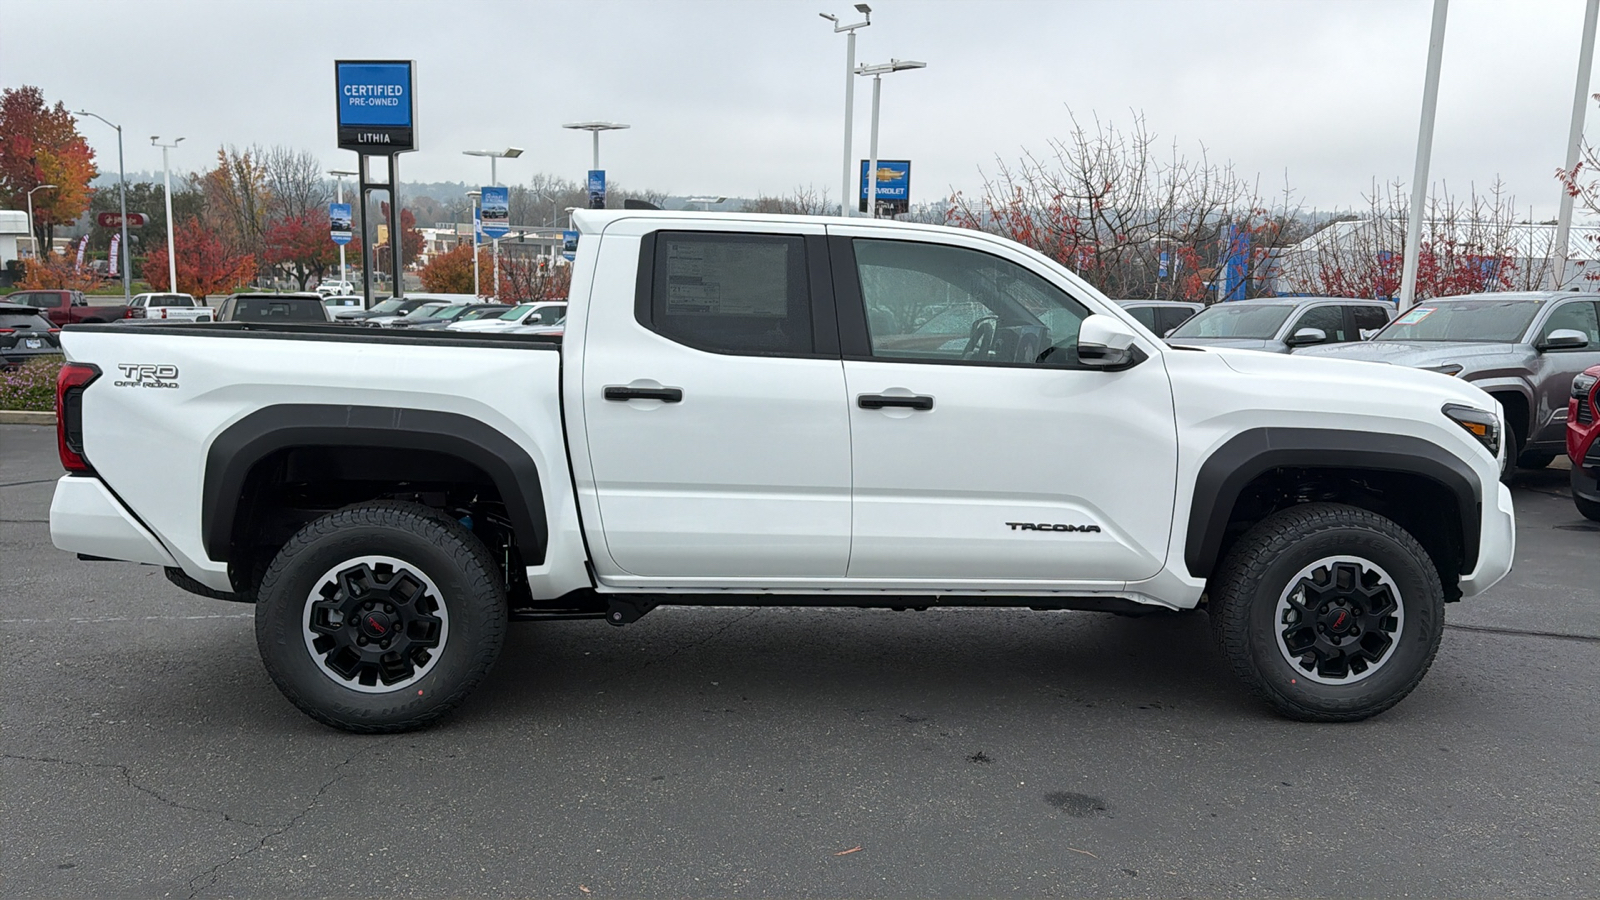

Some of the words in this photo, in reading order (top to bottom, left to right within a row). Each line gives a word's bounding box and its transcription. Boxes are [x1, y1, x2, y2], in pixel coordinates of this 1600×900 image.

[344, 85, 403, 96] CERTIFIED
[349, 98, 399, 106] PRE-OWNED
[358, 133, 391, 143] LITHIA
[863, 187, 905, 195] CEVROLET
[118, 363, 179, 382] TRD
[1005, 522, 1101, 533] TACOMA
